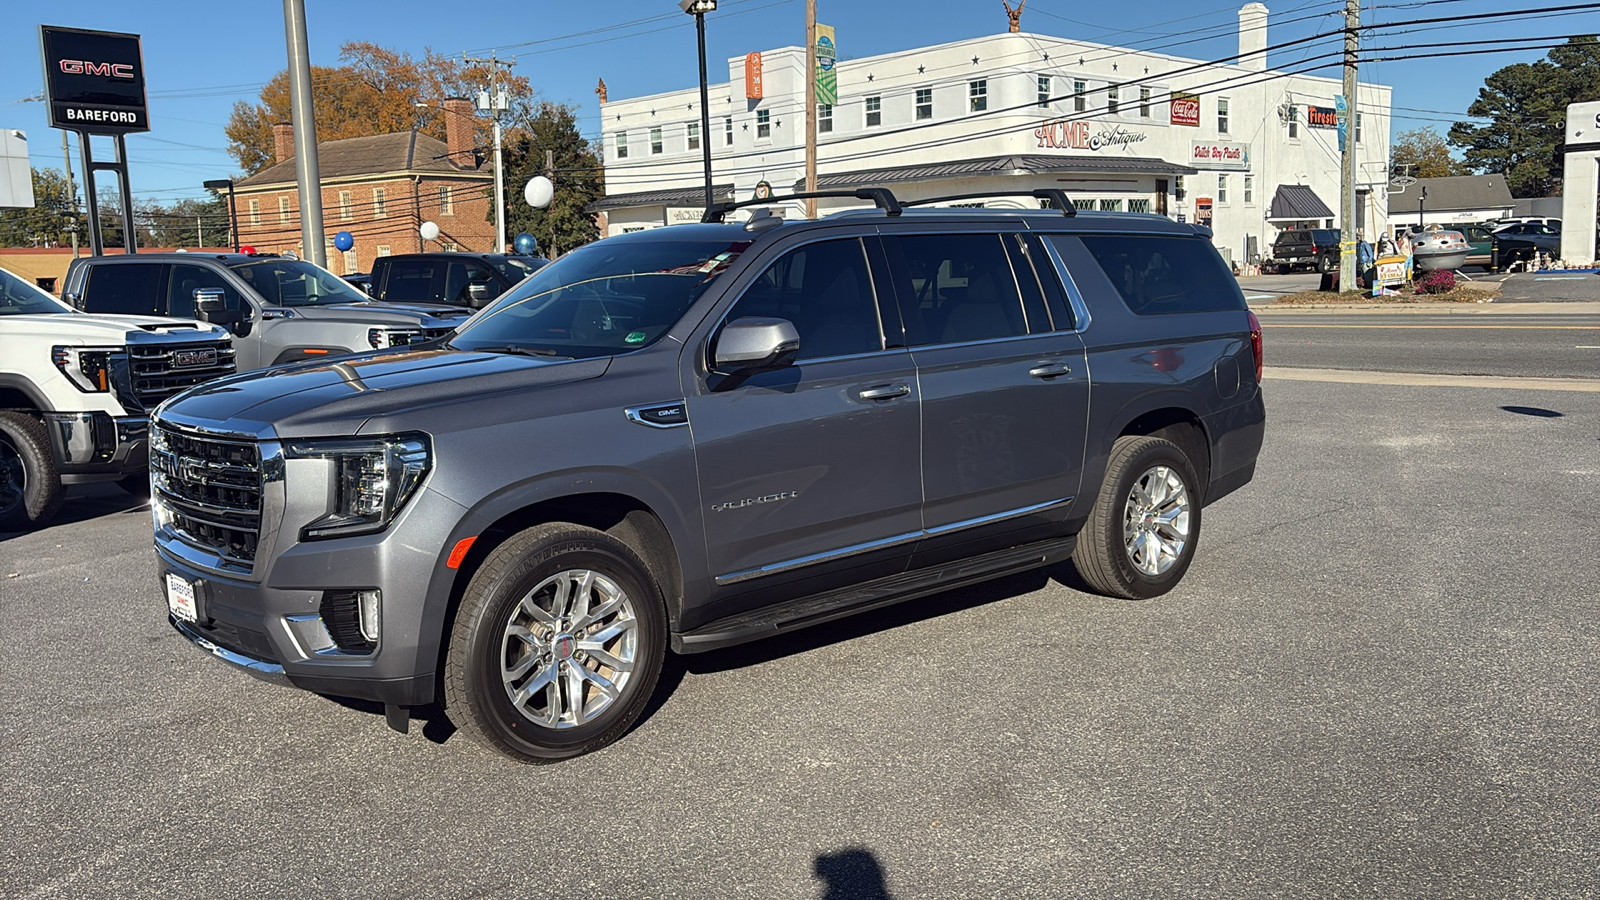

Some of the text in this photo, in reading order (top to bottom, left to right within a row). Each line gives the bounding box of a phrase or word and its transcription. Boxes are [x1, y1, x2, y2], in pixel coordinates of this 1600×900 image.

[59, 59, 134, 78] GMC
[752, 54, 761, 96] ACME
[66, 108, 137, 123] BAREFORD
[1308, 106, 1337, 126] Firesto
[1034, 120, 1090, 150] ACME
[1102, 123, 1147, 151] Antiques
[1194, 145, 1240, 161] Dutch Boy Paints
[178, 351, 215, 365] GMC
[658, 408, 680, 417] GMC
[711, 491, 798, 512] YUKON
[171, 580, 194, 599] BAREFORD
[177, 595, 190, 607] GMC
